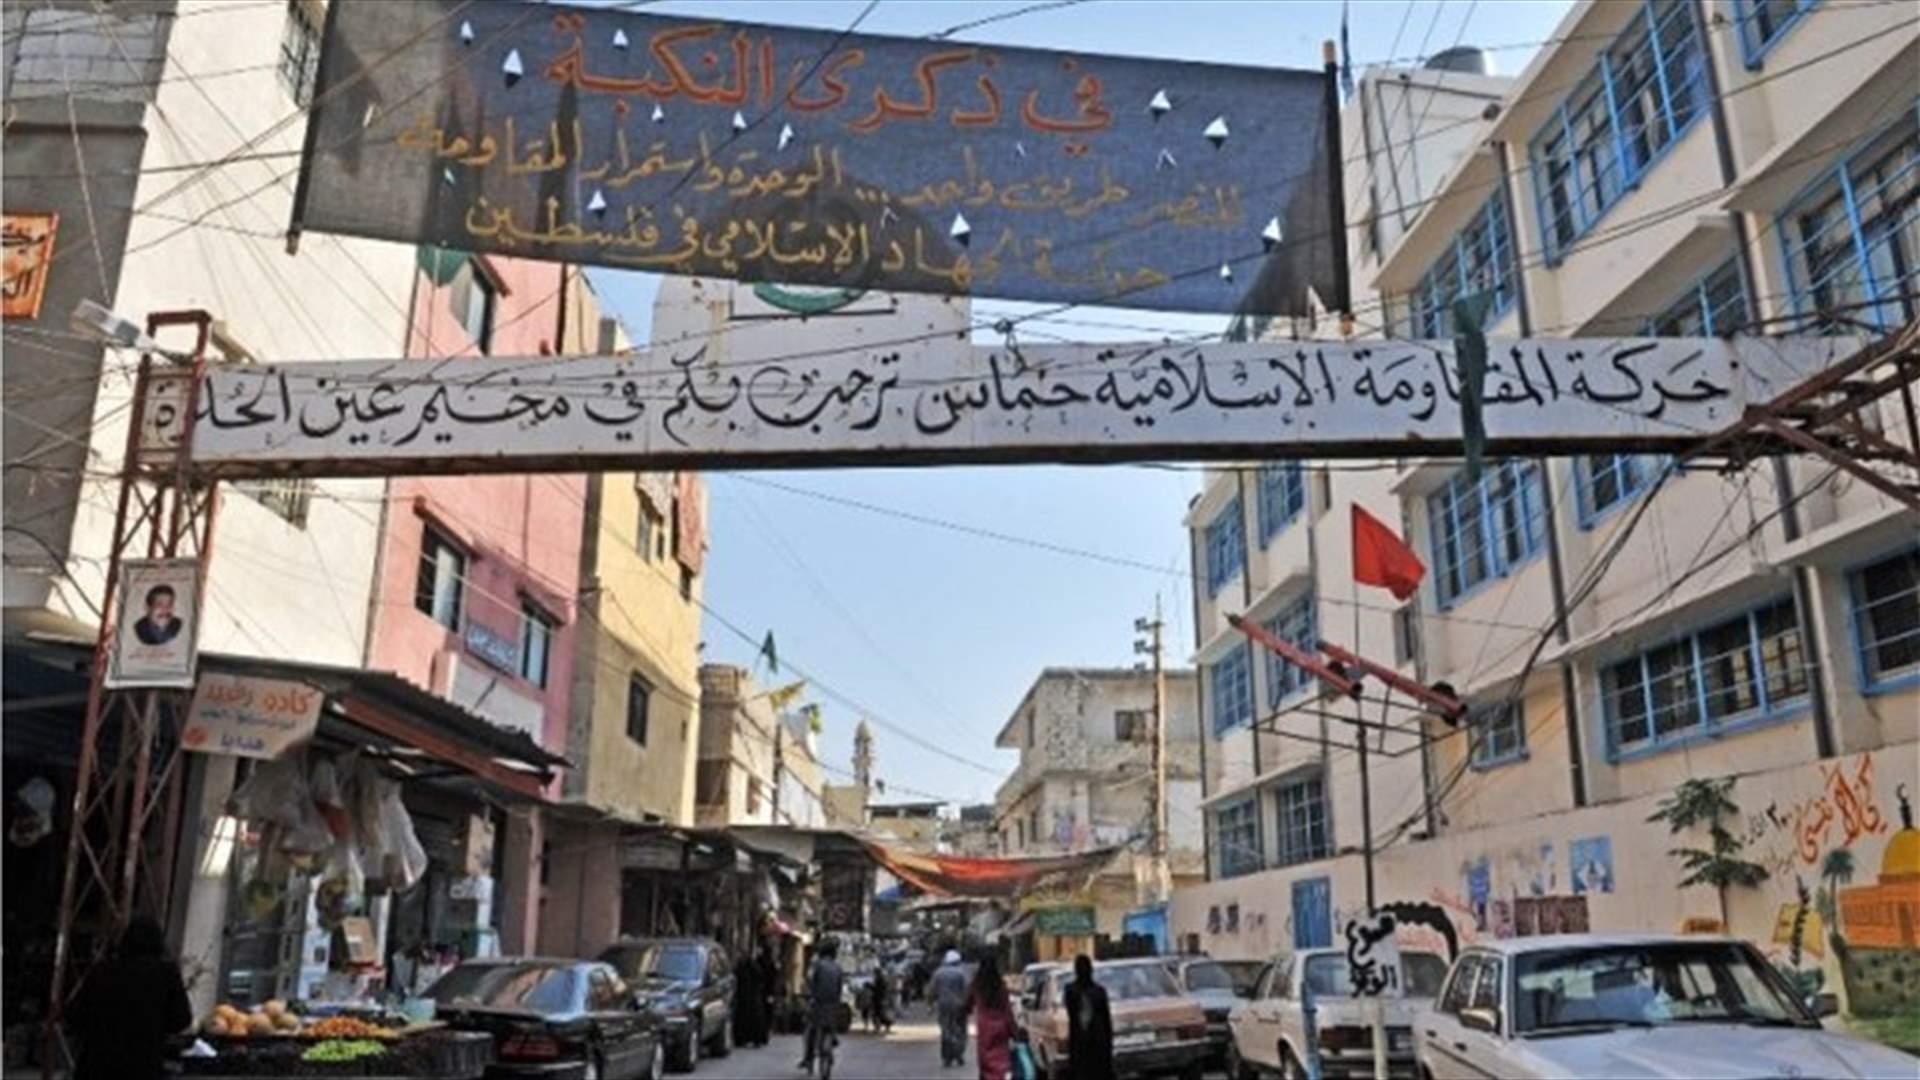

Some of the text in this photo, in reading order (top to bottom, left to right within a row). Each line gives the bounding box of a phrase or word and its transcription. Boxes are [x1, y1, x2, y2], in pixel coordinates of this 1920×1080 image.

[543, 13, 1112, 156] في ذكرى النكبة
[395, 111, 583, 177] المقاومة
[577, 126, 726, 192] واستمرار
[726, 144, 843, 198] الوحدة
[464, 195, 660, 248] فلسطين
[598, 203, 700, 273] في
[156, 367, 292, 446] الحلة
[299, 375, 406, 445] عين
[393, 368, 571, 446] مخيم
[584, 370, 646, 442] في
[661, 346, 742, 447] بكم
[747, 353, 902, 433] ترحب
[914, 355, 1092, 436] حماس
